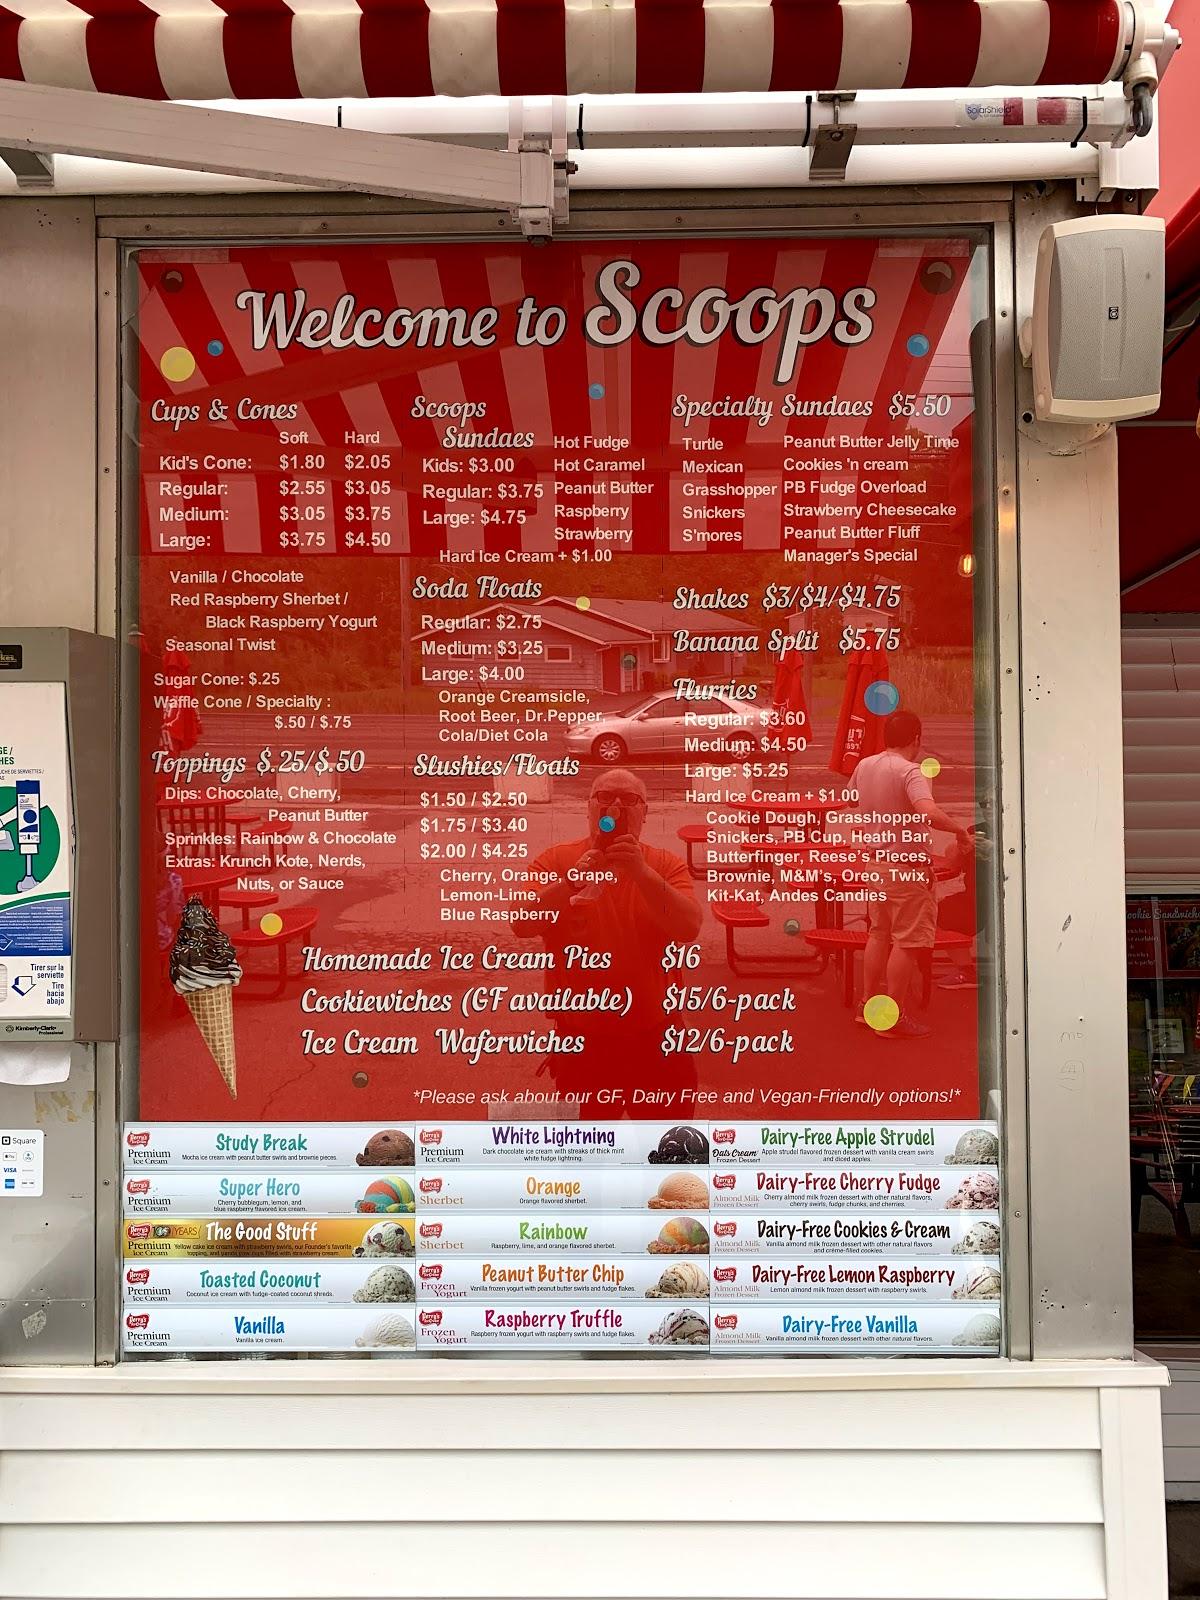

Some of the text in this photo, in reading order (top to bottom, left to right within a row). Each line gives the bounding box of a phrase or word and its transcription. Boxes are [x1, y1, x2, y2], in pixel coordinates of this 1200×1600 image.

[237, 261, 876, 384] Welcome to Scoops
[152, 398, 297, 430] Cups & Cones
[411, 396, 486, 428] Scoops
[673, 391, 952, 426] Specialty Sundaes $5.50
[280, 431, 379, 444] Soft Hard
[443, 425, 534, 448] Sundaes
[554, 436, 629, 451] Hot Fudge
[682, 438, 723, 450] Turtle
[160, 455, 251, 470] Kid's Cone:
[280, 454, 390, 470] $1.80 $2.05
[423, 457, 514, 474] Kids: $3.00
[424, 509, 526, 528] Large: $4.75
[555, 527, 632, 542] Strawberry
[683, 529, 742, 541] S'mores
[785, 549, 917, 564] Manager's Special
[170, 570, 303, 583] Vanilla / Chocolate
[412, 576, 542, 598] Soda Floats
[673, 582, 901, 612] Shakes $3/$4/$4.75
[673, 625, 900, 660] Banana Split $5.75
[154, 672, 280, 688] Sugar Cone: $.25
[673, 678, 757, 701] Flurries
[439, 729, 547, 741] Cola/Diet Cola
[152, 746, 365, 782] Toppings $.25/$.50
[413, 753, 579, 775] Slushies/Floats
[238, 877, 344, 892] Nuts, or Sauce
[441, 888, 540, 903] Lemon-Lime,
[708, 889, 887, 904] Kit-Kat, Andes Candies
[441, 908, 559, 923] Blue Raspberry
[1127, 908, 1152, 920] ookie
[302, 983, 796, 1020] Cookiewiches (GF available) $15/6-pack
[480, 1089, 510, 1104] ask
[514, 1089, 560, 1103] about
[565, 1092, 592, 1104] our
[597, 1090, 625, 1105] GF,
[633, 1089, 676, 1106] Dairy
[681, 1089, 717, 1103] Free
[723, 1088, 754, 1103] and
[760, 1088, 885, 1106] Vegan-Friendly
[216, 1134, 307, 1153] Study Break
[492, 1126, 614, 1147] White Lightning
[762, 1128, 934, 1149] Dairy-Free Apple Strudel
[128, 1149, 171, 1157] Premium
[421, 1147, 464, 1156] Premium
[713, 1149, 757, 1157] Oats Cream
[219, 1178, 300, 1200] Super Hero
[527, 1177, 580, 1197] Orange
[757, 1172, 940, 1193] Dairy-Free Cherry Fudge
[420, 1196, 464, 1204] Sherbet
[206, 1222, 317, 1240] The Good Stuff
[520, 1222, 588, 1240] Rainbow
[758, 1220, 950, 1240] Dairy-Free Cookies & Cream
[200, 1270, 321, 1288] Toasted Coconut
[483, 1264, 624, 1285] Peanut Butter Chip
[752, 1265, 955, 1286] Dairy-Free Lemon Raspberry
[422, 1282, 455, 1290] Frozen
[435, 1290, 466, 1298] Yogurt
[234, 1316, 284, 1334] Vanilla
[486, 1309, 622, 1331] Raspberry Truffle
[783, 1315, 917, 1335] Dairy-Free Vanilla
